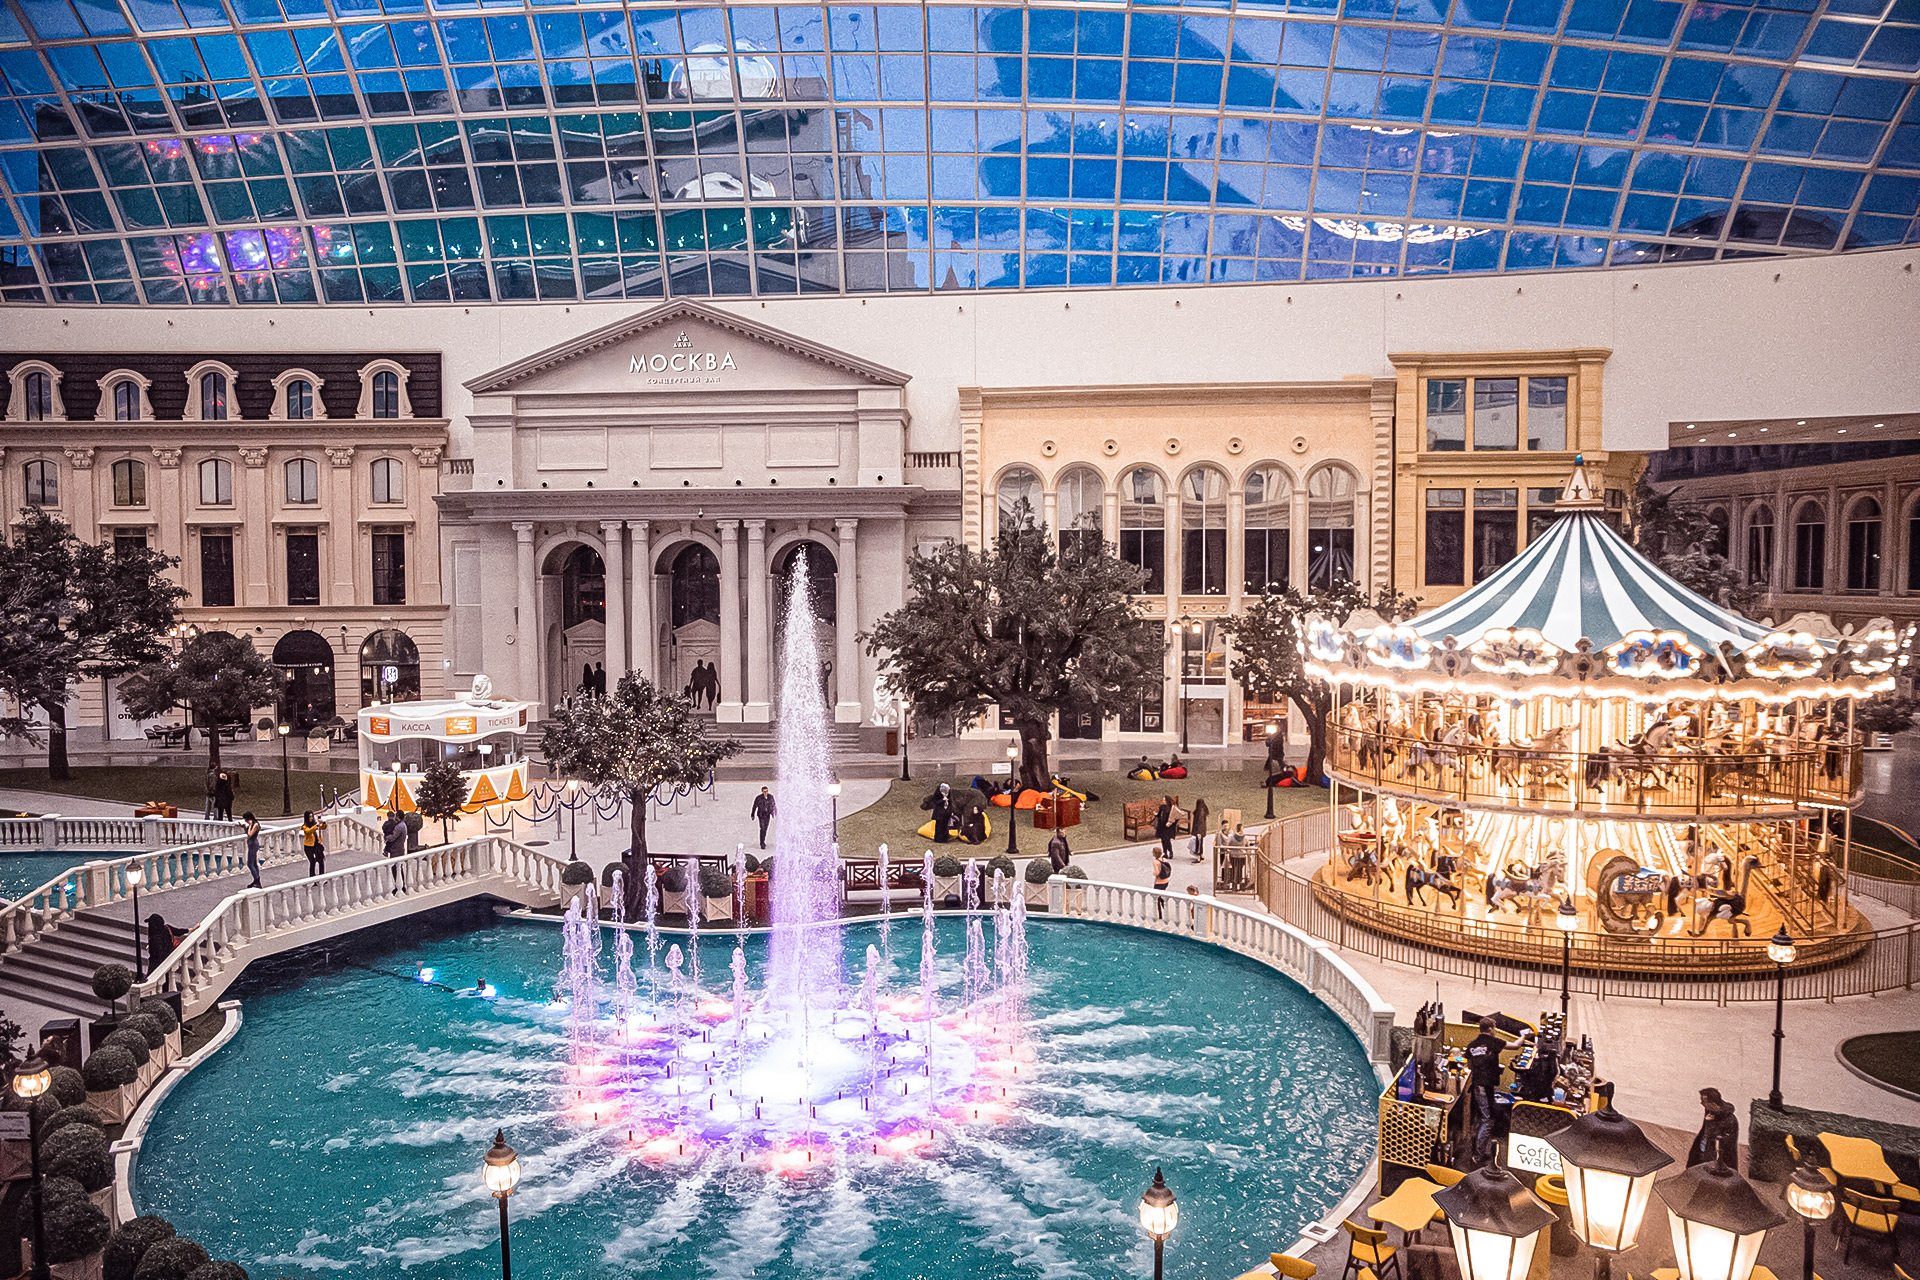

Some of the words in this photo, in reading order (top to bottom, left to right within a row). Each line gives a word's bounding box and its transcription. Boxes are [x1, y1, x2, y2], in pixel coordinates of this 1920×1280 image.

[629, 352, 737, 373] МОСКВА
[647, 376, 701, 385] КОНЦЕРТНЫЙ
[488, 717, 514, 727] TICKETS
[401, 723, 431, 731] КАССА
[458, 745, 465, 753] 2
[1516, 1143, 1558, 1161] Coffe
